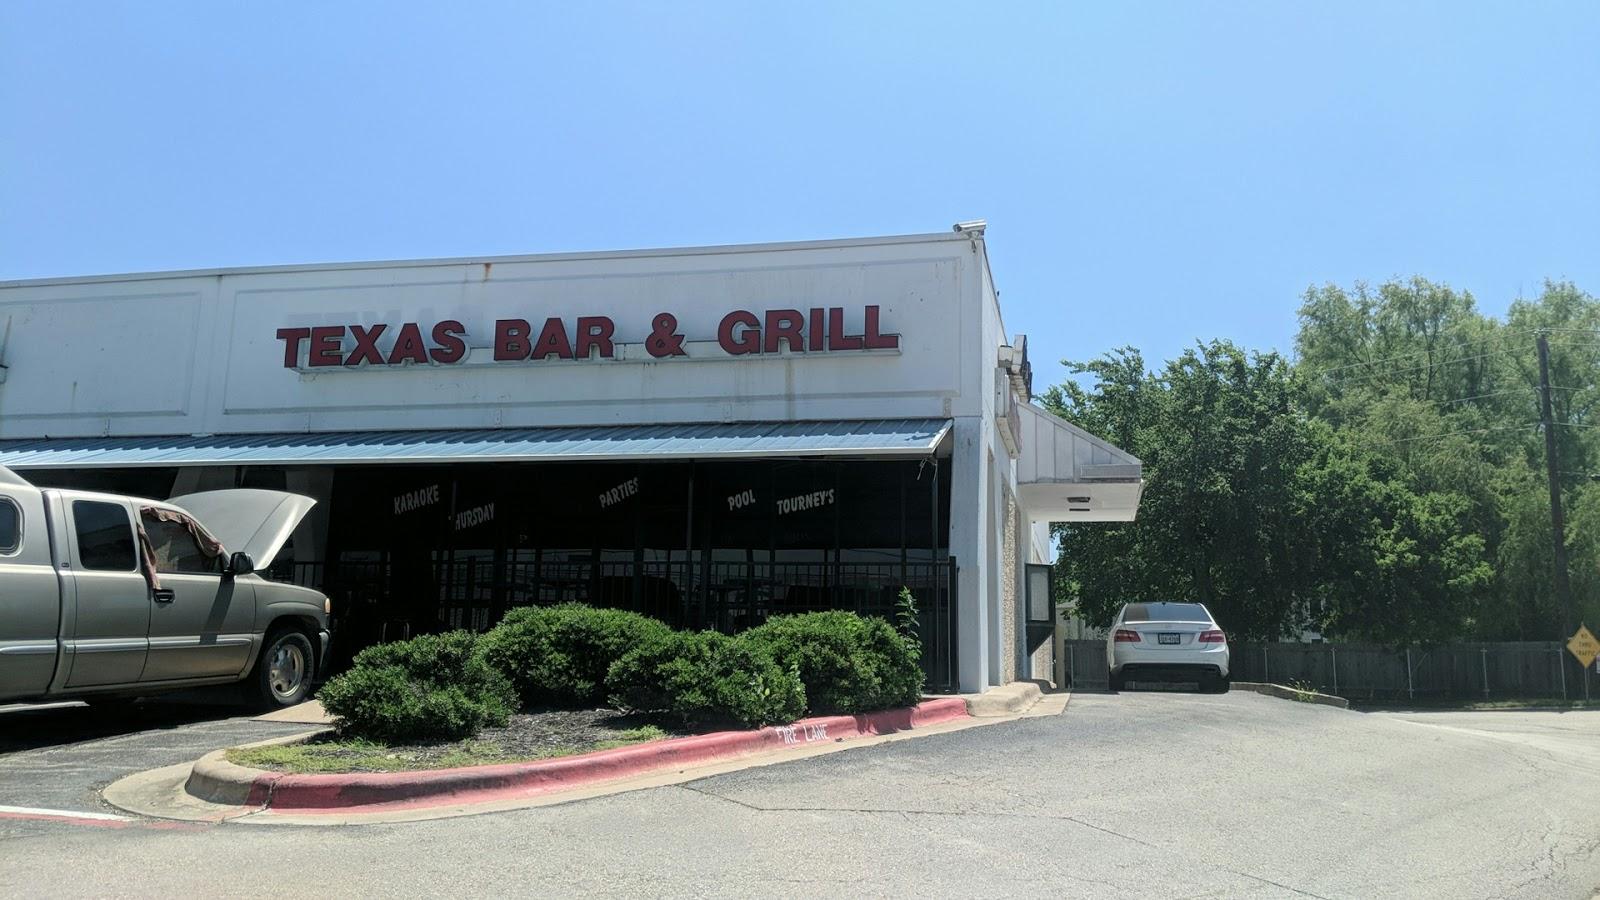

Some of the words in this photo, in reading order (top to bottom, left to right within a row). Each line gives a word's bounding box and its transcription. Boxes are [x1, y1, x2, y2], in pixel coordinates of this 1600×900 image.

[276, 320, 467, 369] TEXAS
[494, 316, 615, 361] BAR
[645, 312, 688, 358] &
[718, 305, 899, 355] GRILL
[394, 484, 440, 515] KARAOKE
[599, 477, 639, 508] PARTIES
[727, 489, 756, 511] POOL
[776, 488, 835, 515] TOURNEY'S
[450, 502, 495, 530] HURSDAY
[775, 726, 801, 745] FIRE
[803, 723, 830, 742] LANE
